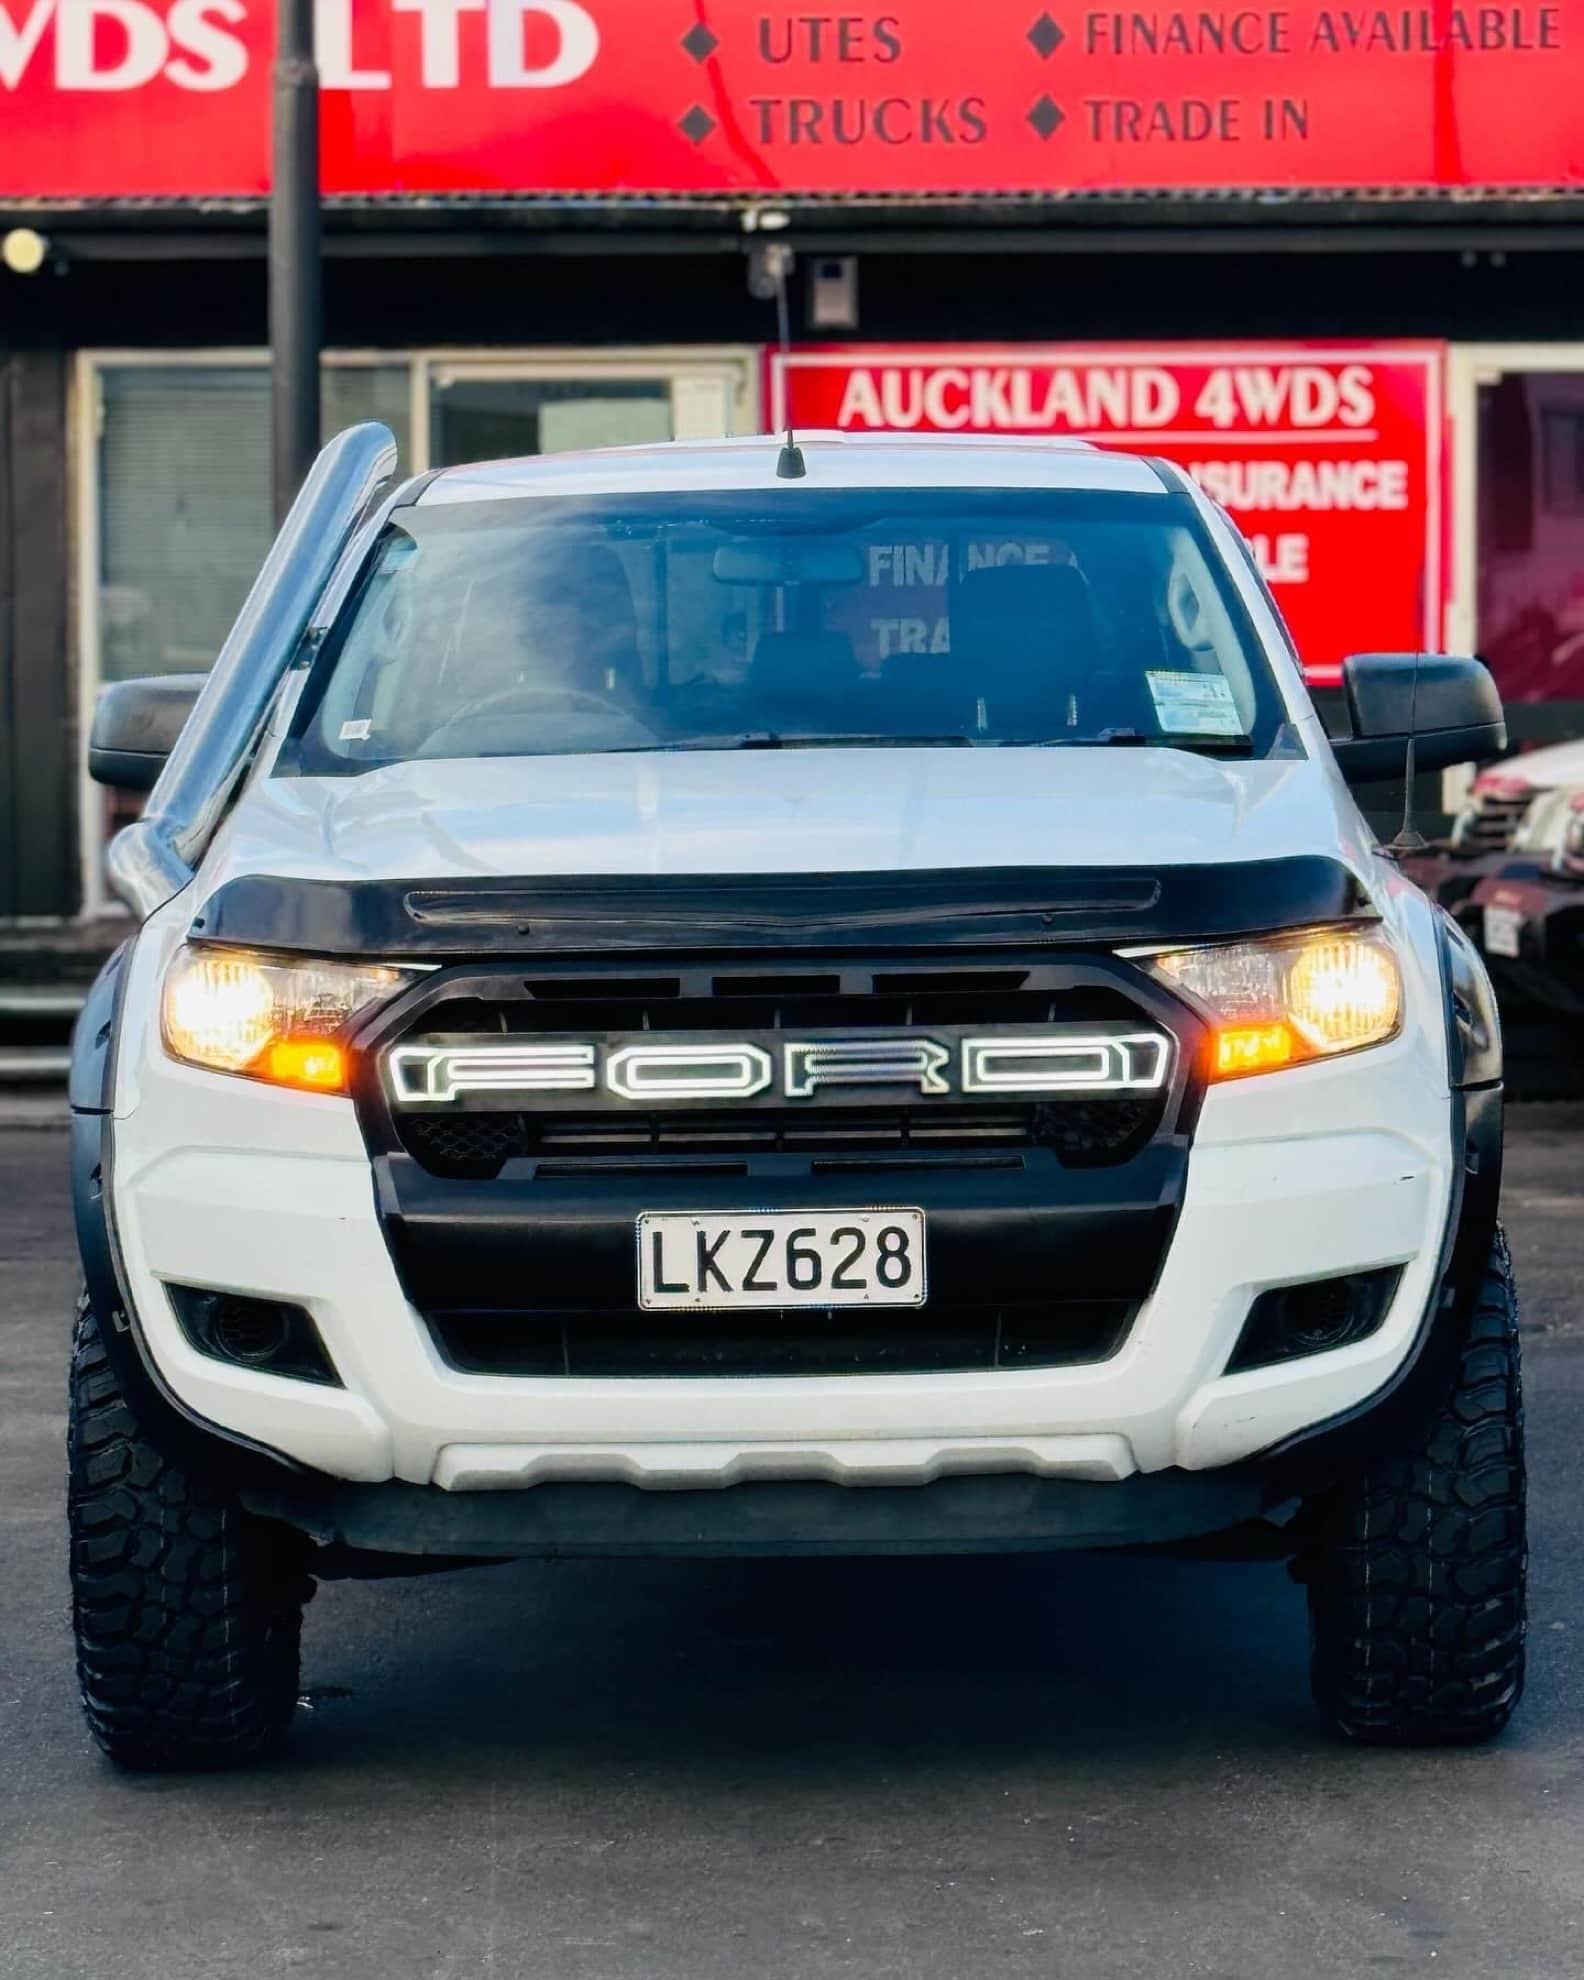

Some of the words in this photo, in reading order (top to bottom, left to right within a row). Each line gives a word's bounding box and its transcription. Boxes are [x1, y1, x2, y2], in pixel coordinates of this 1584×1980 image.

[314, 0, 600, 90] LTD
[758, 16, 901, 63] UTES
[1086, 12, 1290, 55] FINANCE
[1311, 9, 1561, 52] AVAILABLE
[750, 97, 987, 144] TRUCKS
[1084, 100, 1241, 142] TRADE
[1264, 99, 1309, 141] IN
[837, 367, 1181, 429] AUCKLAND
[1194, 366, 1376, 428] 4WDS
[389, 1032, 1169, 1102] FORD
[652, 1226, 912, 1293] LKZ628
